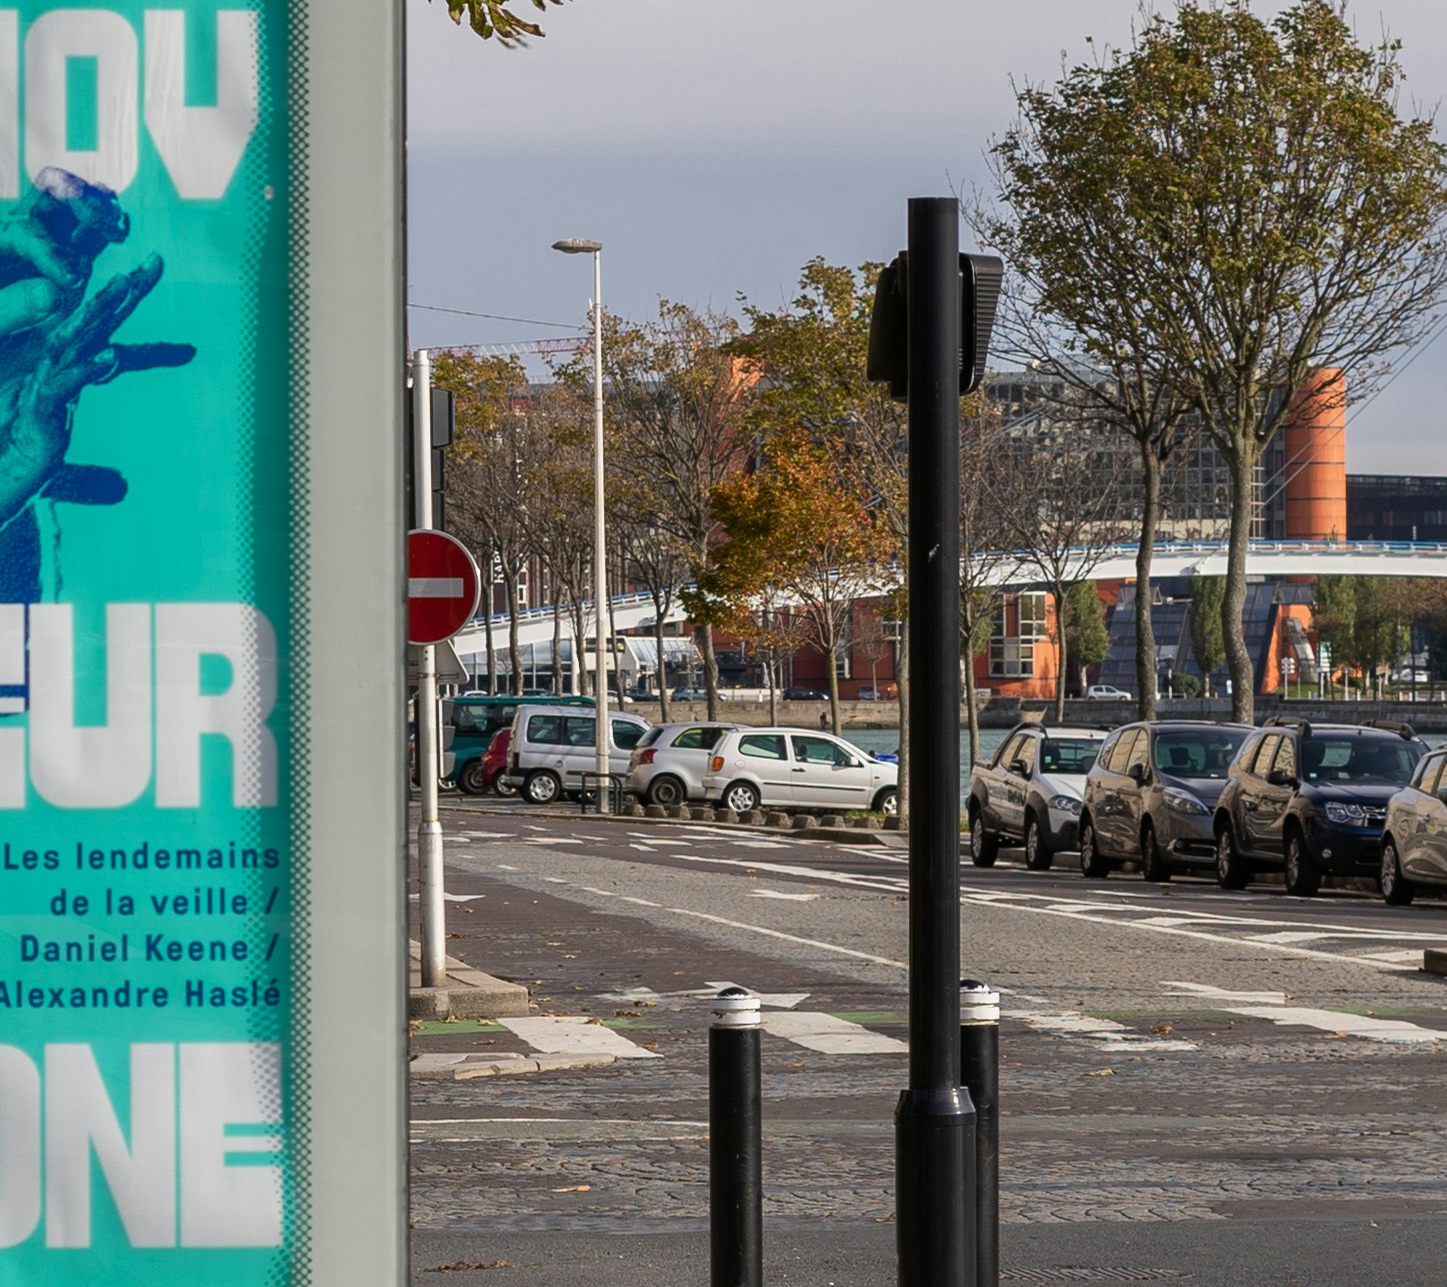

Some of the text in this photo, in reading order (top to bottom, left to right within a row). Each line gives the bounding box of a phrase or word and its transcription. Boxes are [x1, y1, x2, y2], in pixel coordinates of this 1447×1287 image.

[4, 843, 61, 870] Les
[76, 842, 281, 869] lendemains
[50, 888, 89, 915] de
[106, 888, 135, 915] la
[151, 888, 248, 915] veille
[20, 934, 129, 962] Daniel
[146, 934, 249, 962] Keene
[185, 978, 281, 1008] Haslé
